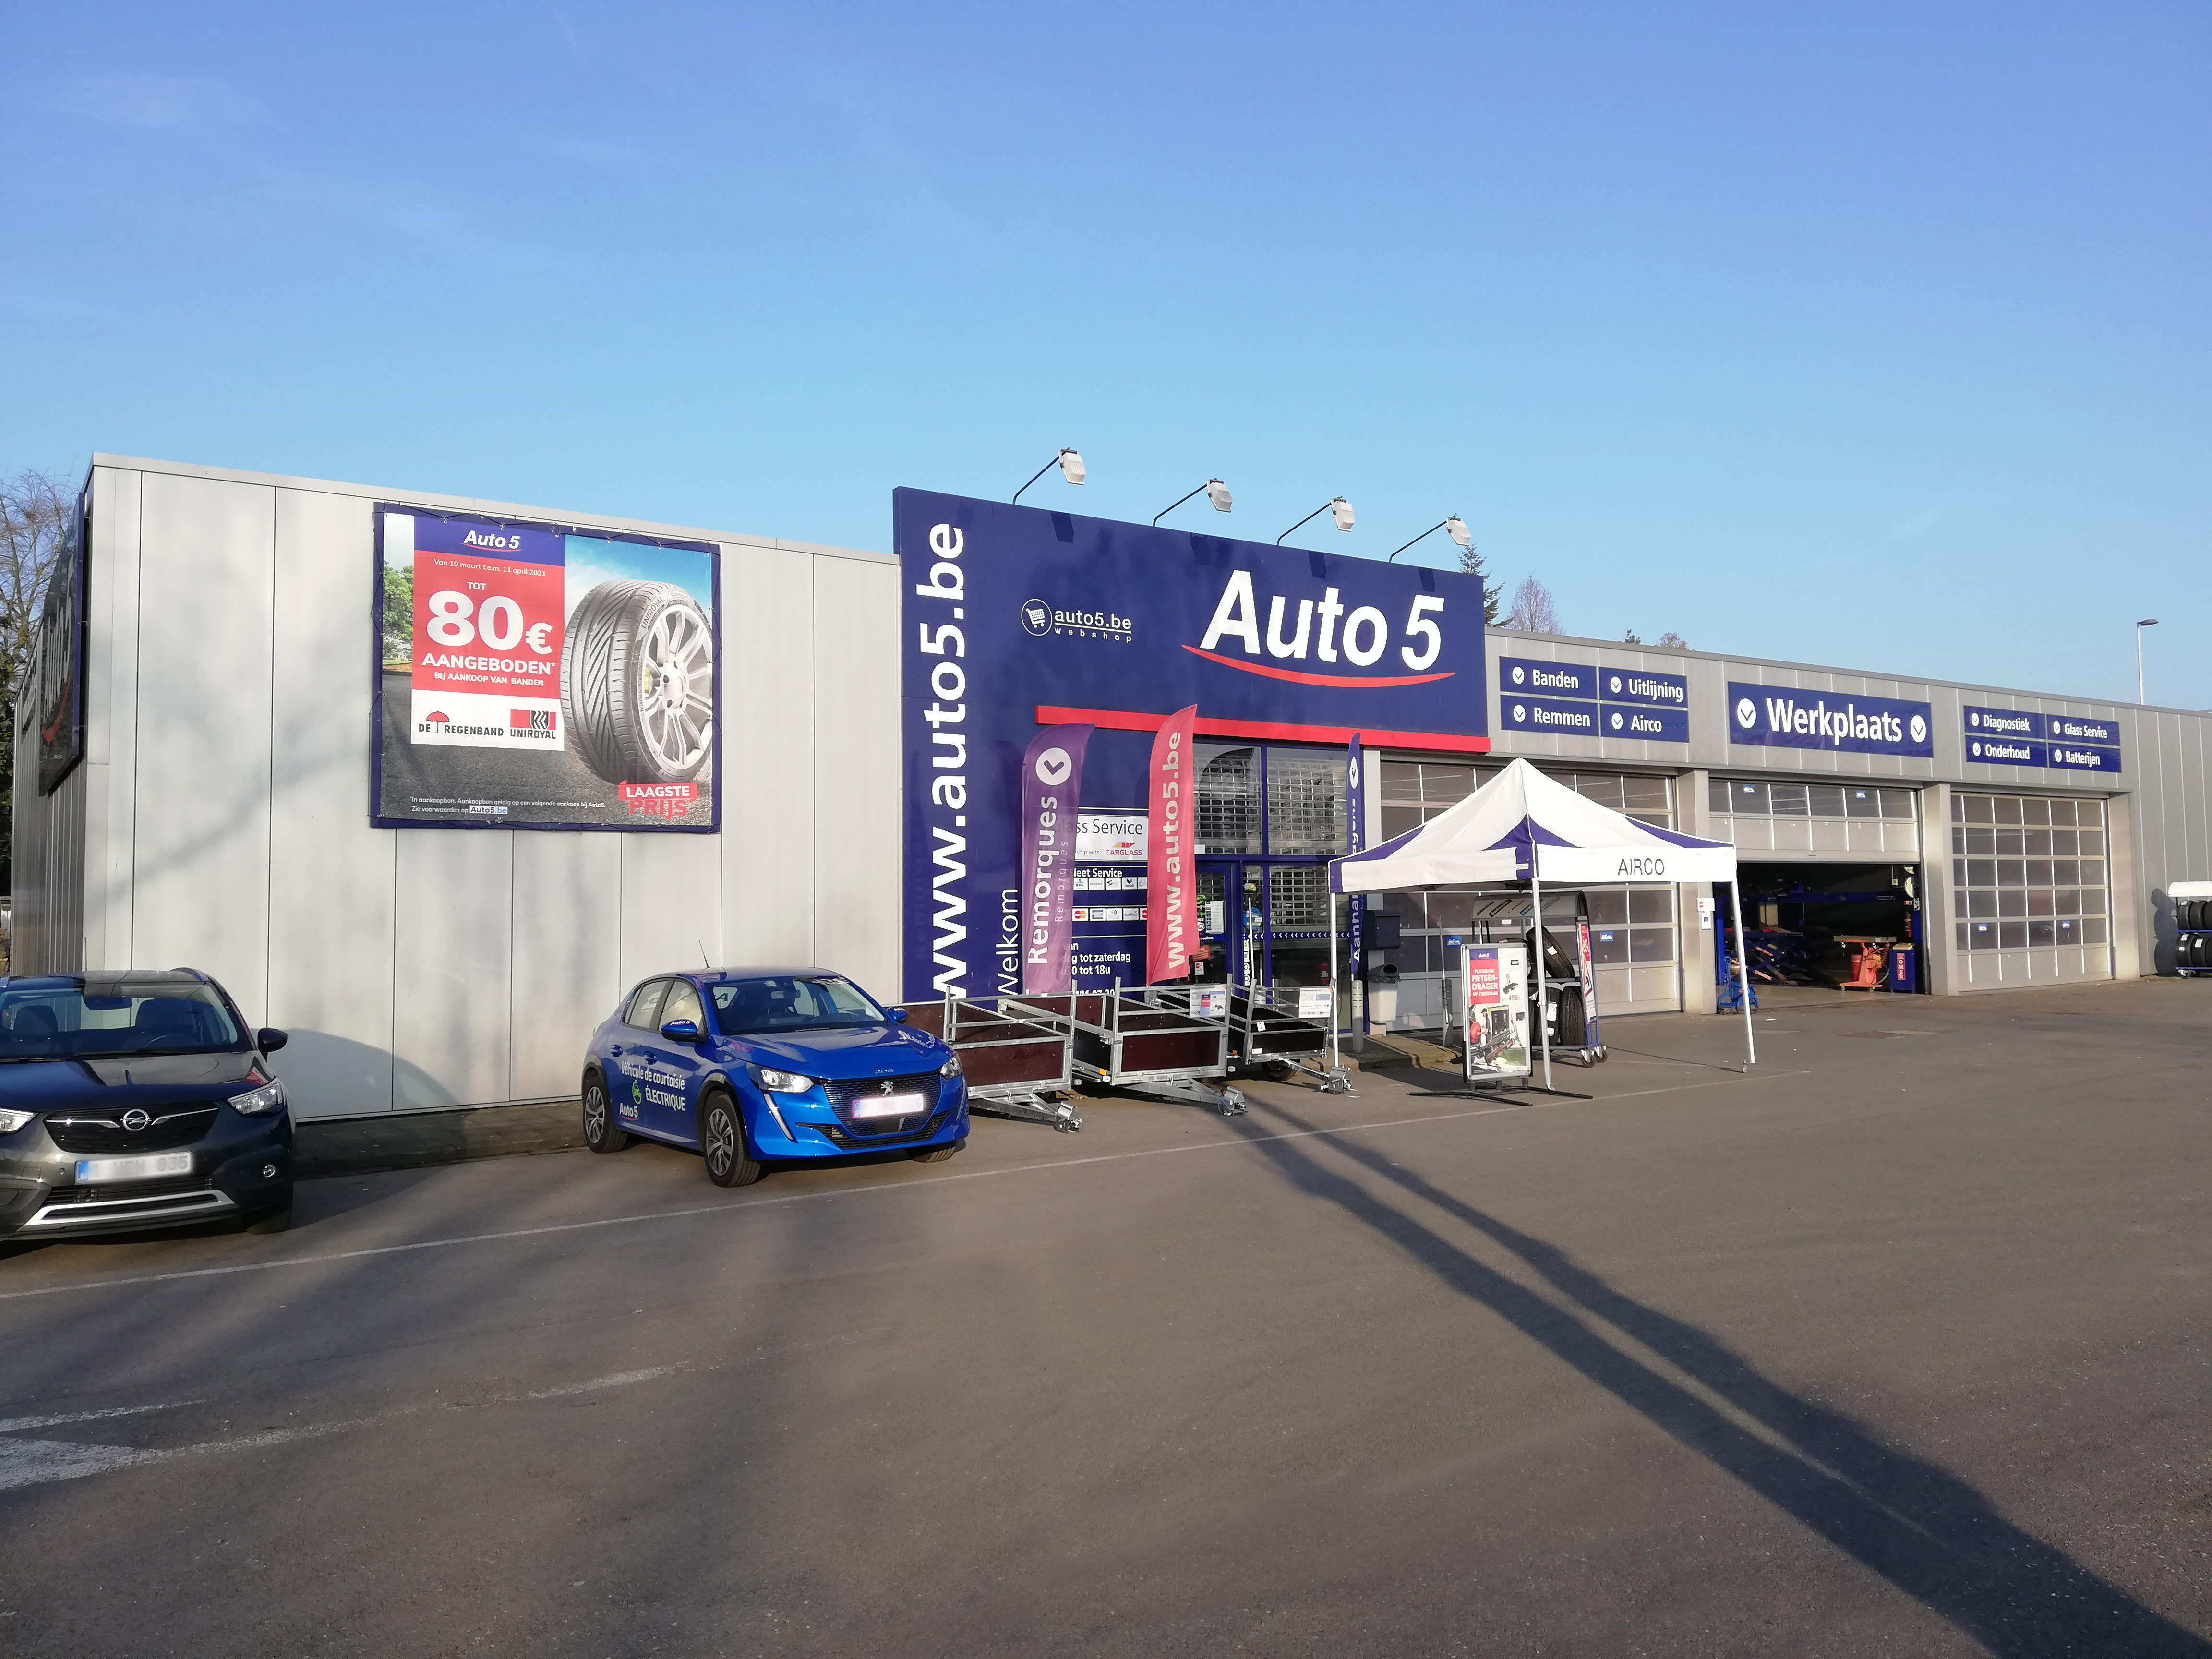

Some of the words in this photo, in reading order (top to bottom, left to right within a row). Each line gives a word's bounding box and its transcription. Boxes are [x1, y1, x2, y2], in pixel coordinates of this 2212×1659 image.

[463, 530, 506, 547] Auto
[508, 535, 520, 549] 5
[467, 581, 487, 591] TOT
[641, 597, 665, 629] UNIROYAL
[1055, 610, 1131, 629] auto5.be
[1200, 569, 1387, 667] Auto
[1401, 594, 1445, 671] 5
[1055, 628, 1131, 643] webshop
[434, 672, 445, 681] BIJ
[447, 673, 488, 682] AANKOOP
[511, 677, 543, 686] BANDEN
[1532, 669, 1579, 689] Banden
[1629, 678, 1683, 703] Uitlijning
[1534, 707, 1590, 727] Remmen
[1631, 715, 1662, 733] Airco
[1766, 697, 1902, 745] Werkplaats
[1983, 714, 2031, 732] Diagnostiek
[419, 723, 431, 733] DE
[444, 724, 504, 736] REGENBAND
[510, 729, 556, 739] UNIROYAL
[2065, 723, 2082, 736] Glass
[2084, 725, 2107, 739] Service
[1985, 744, 2031, 760] Onderhoud
[2066, 750, 2101, 768] Batterijen
[916, 523, 967, 1000] www.auto5.be
[626, 785, 690, 798] LAAGSTE
[629, 799, 688, 819] PRIJS
[1093, 818, 1142, 835] Service
[1162, 731, 1184, 969] www.auto5.be
[1074, 867, 1090, 878] leet
[1093, 868, 1123, 878] Service
[1618, 858, 1664, 875] AIRCO
[1027, 795, 1059, 964] Remorques
[1055, 841, 1068, 922] Remorques
[996, 888, 1018, 996] Welkom
[1080, 953, 1093, 962] tot
[1094, 951, 1131, 963] zaterdag
[1080, 966, 1093, 974] tot
[1095, 965, 1110, 974] 18u
[1472, 982, 1498, 990] DRAGER
[622, 1061, 644, 1080] Véhicule
[645, 1067, 652, 1081] de
[653, 1073, 685, 1090] courtoisie
[645, 1085, 686, 1112] ÉLECTRIQUE
